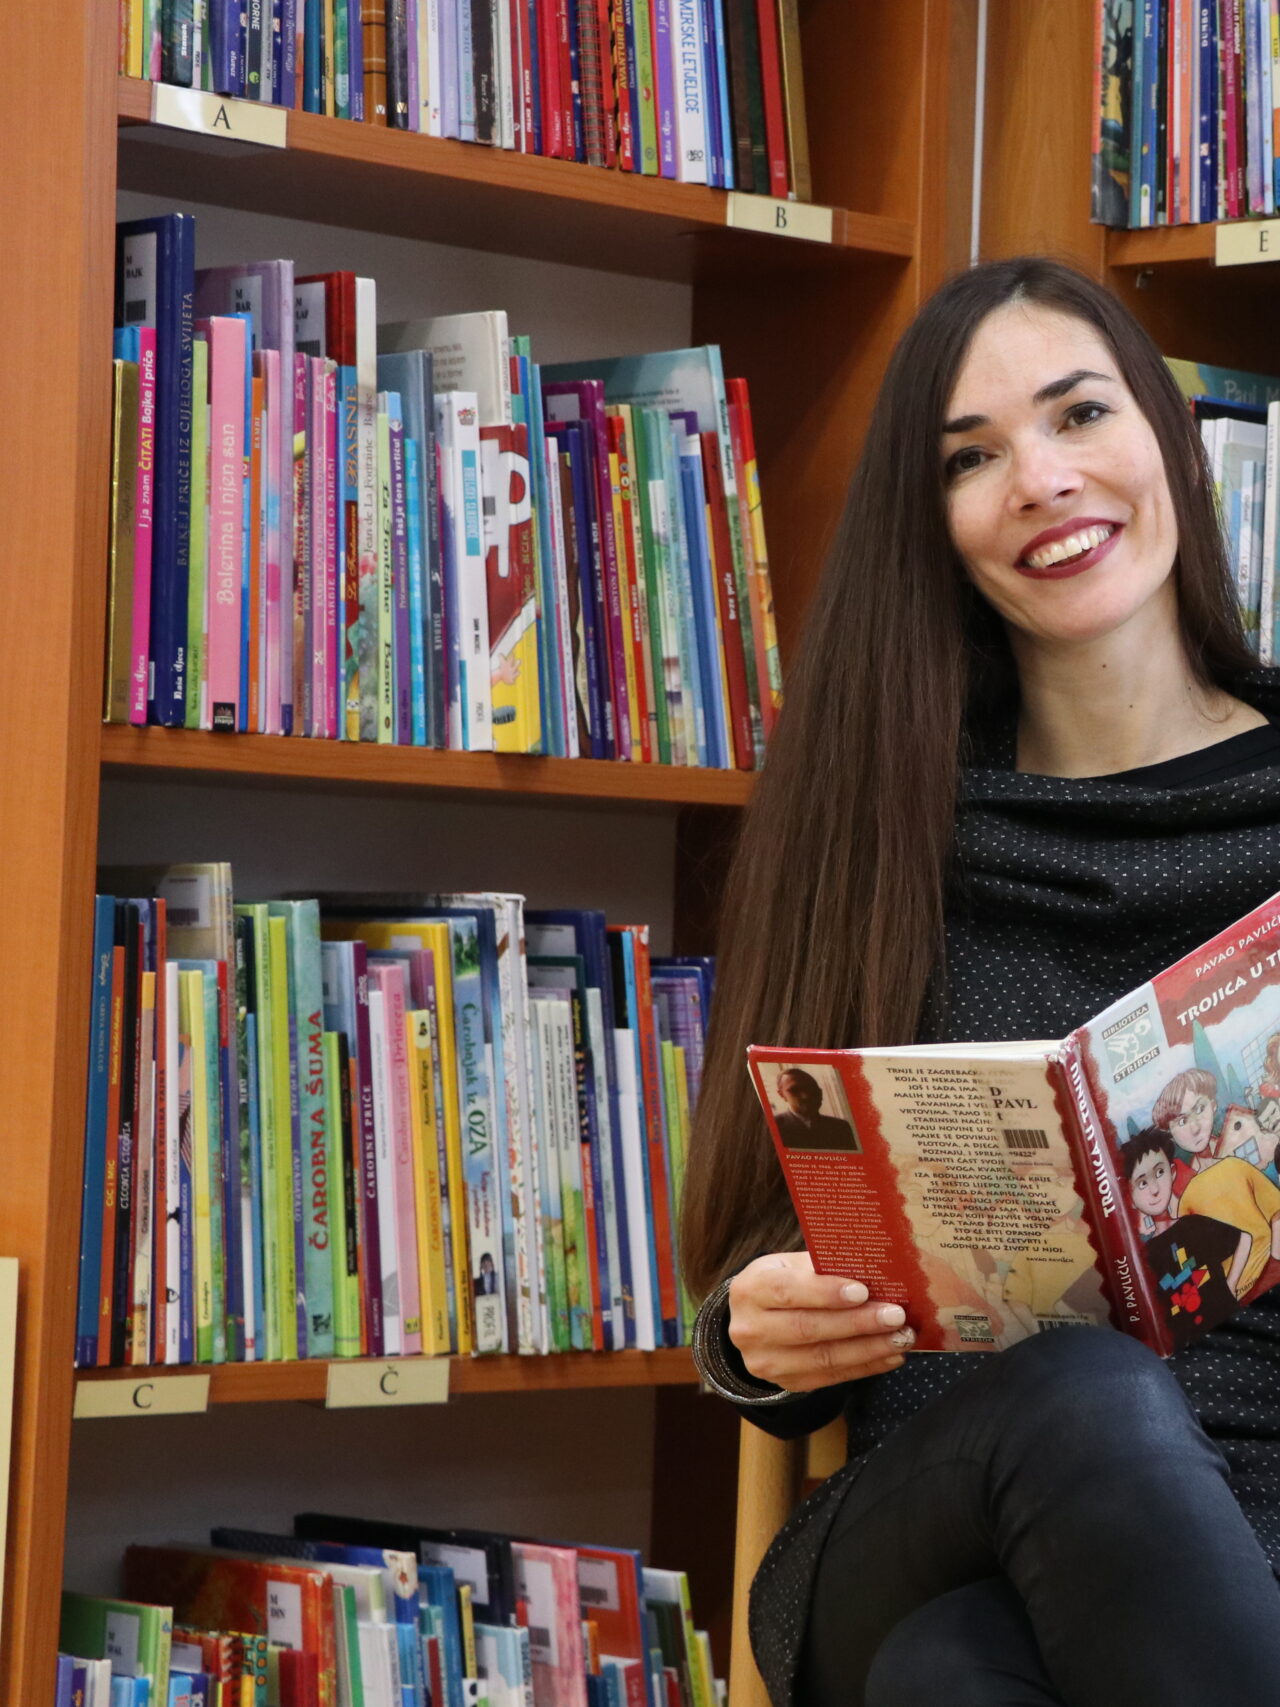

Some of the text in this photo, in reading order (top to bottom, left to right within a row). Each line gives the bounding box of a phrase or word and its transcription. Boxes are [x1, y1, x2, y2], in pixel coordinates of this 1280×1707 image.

[617, 24, 629, 89] AVANTURE
[682, 52, 700, 114] LETJELICE
[213, 104, 231, 129] A
[775, 206, 787, 228] B
[1259, 230, 1269, 252] E
[181, 292, 194, 352] SVIJETA
[142, 350, 155, 381] priče
[139, 427, 153, 471] ČITATI
[221, 424, 236, 458] san
[1194, 945, 1236, 978] PAVAO
[1176, 975, 1247, 1028] TROJICA
[1249, 960, 1264, 981] U
[1102, 1003, 1150, 1041] BIBLIOTEKA
[1113, 1047, 1160, 1083] STRIBOR
[993, 1099, 1038, 1109] PAVL
[303, 1010, 331, 1252] ČAROBNA ŠUMA
[359, 1085, 377, 1200] ČAROBNE PRIČE
[468, 1110, 487, 1157] OZA
[1069, 1062, 1117, 1219] TROJICA TRNJU
[132, 1384, 153, 1408] C
[380, 1366, 399, 1395] Č
